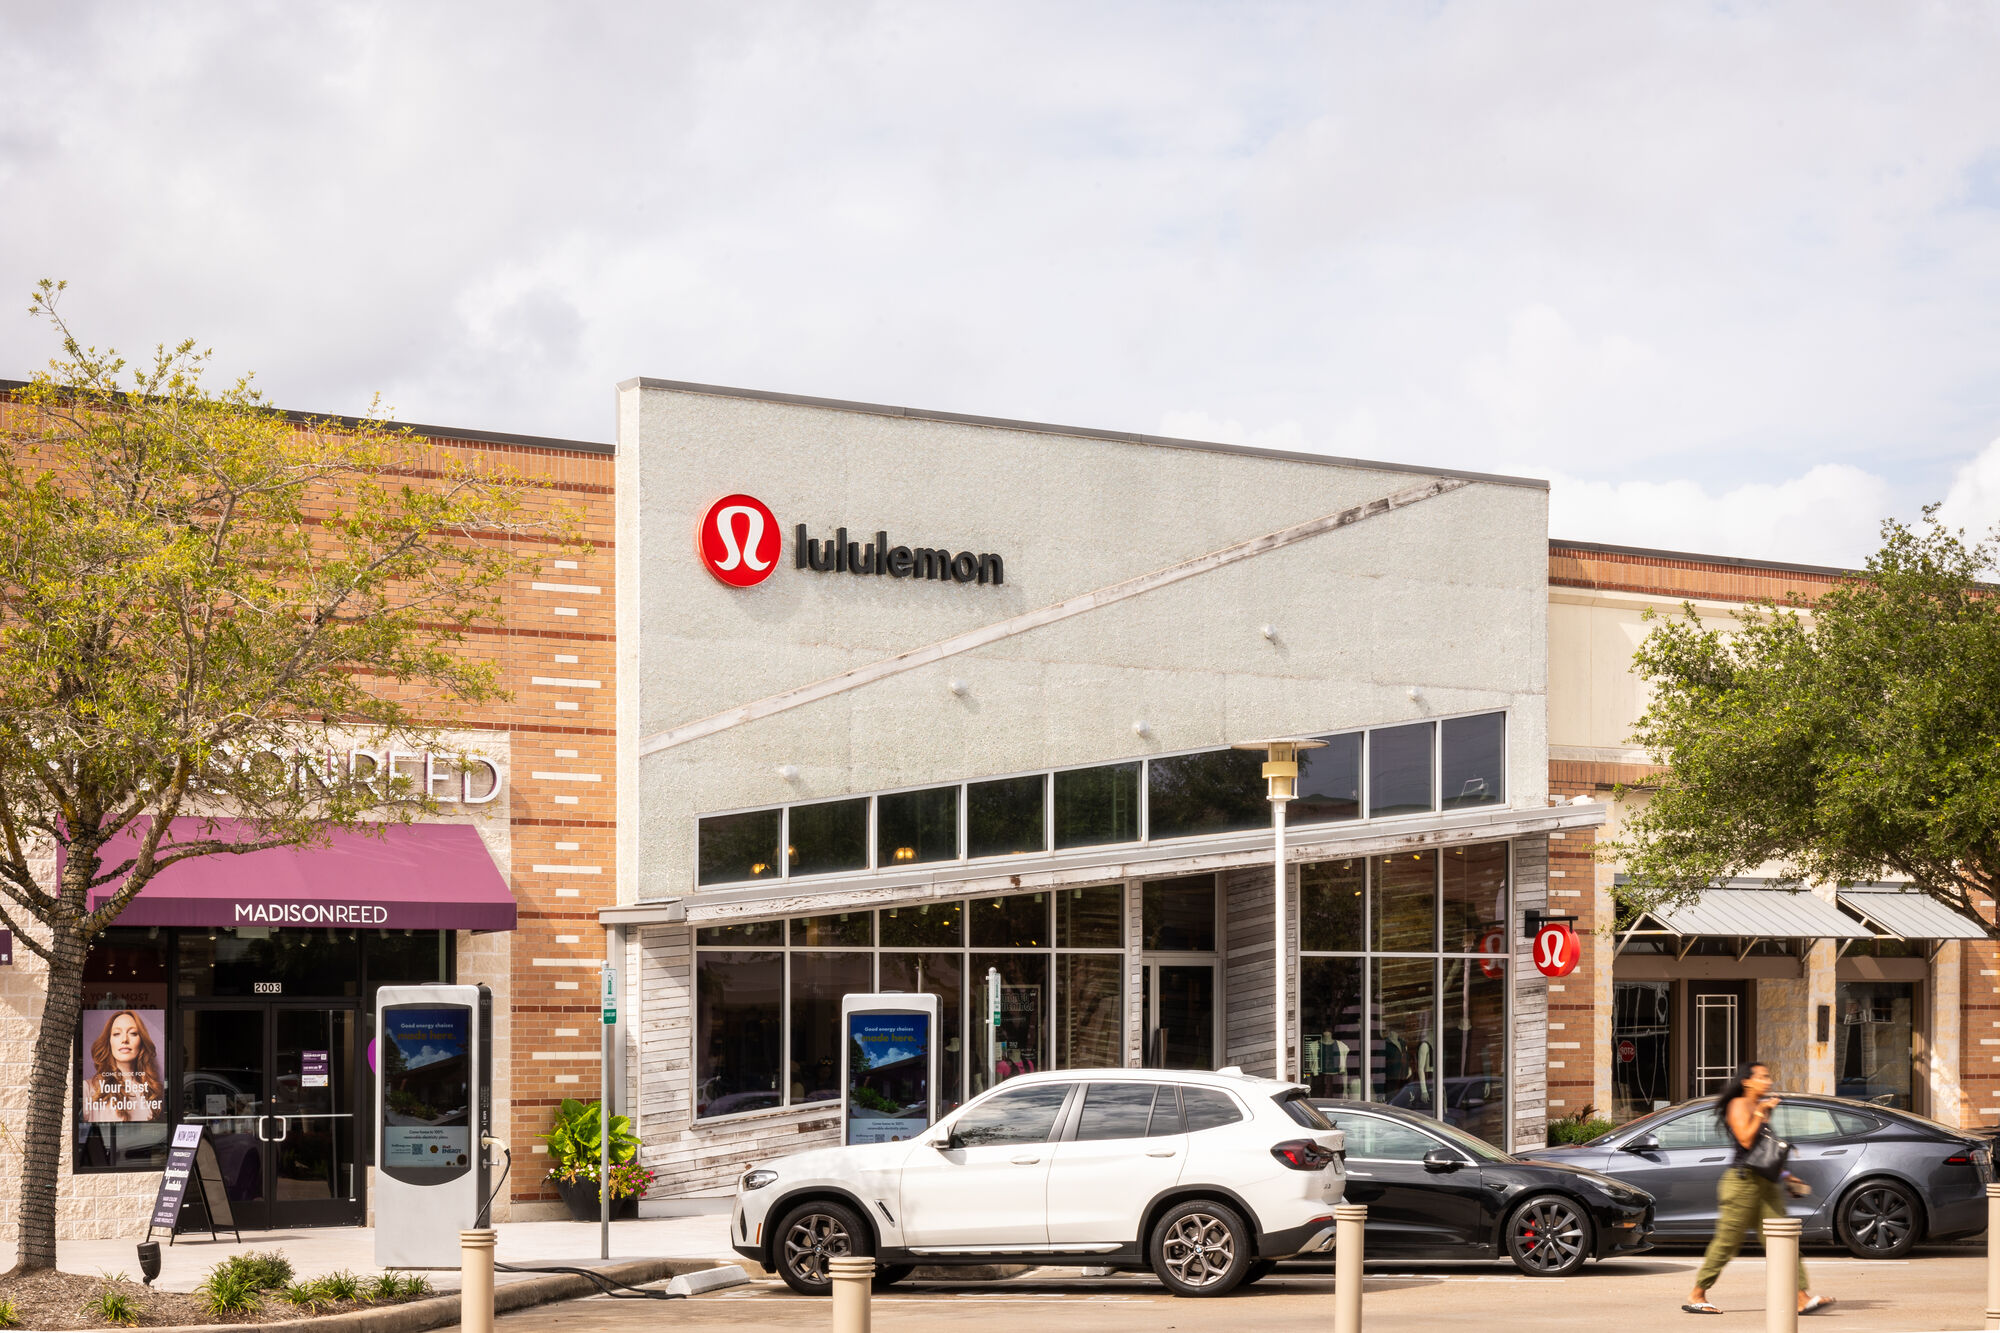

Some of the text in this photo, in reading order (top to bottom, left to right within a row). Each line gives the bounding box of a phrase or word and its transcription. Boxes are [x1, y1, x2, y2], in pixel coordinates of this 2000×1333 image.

[793, 523, 1004, 585] lululemon
[234, 903, 388, 924] MADISONREED
[254, 983, 281, 993] 2003
[397, 1030, 427, 1040] made
[862, 1033, 917, 1042] made here.
[99, 1079, 149, 1094] Your Best
[85, 1096, 163, 1111] Hair Color Ever
